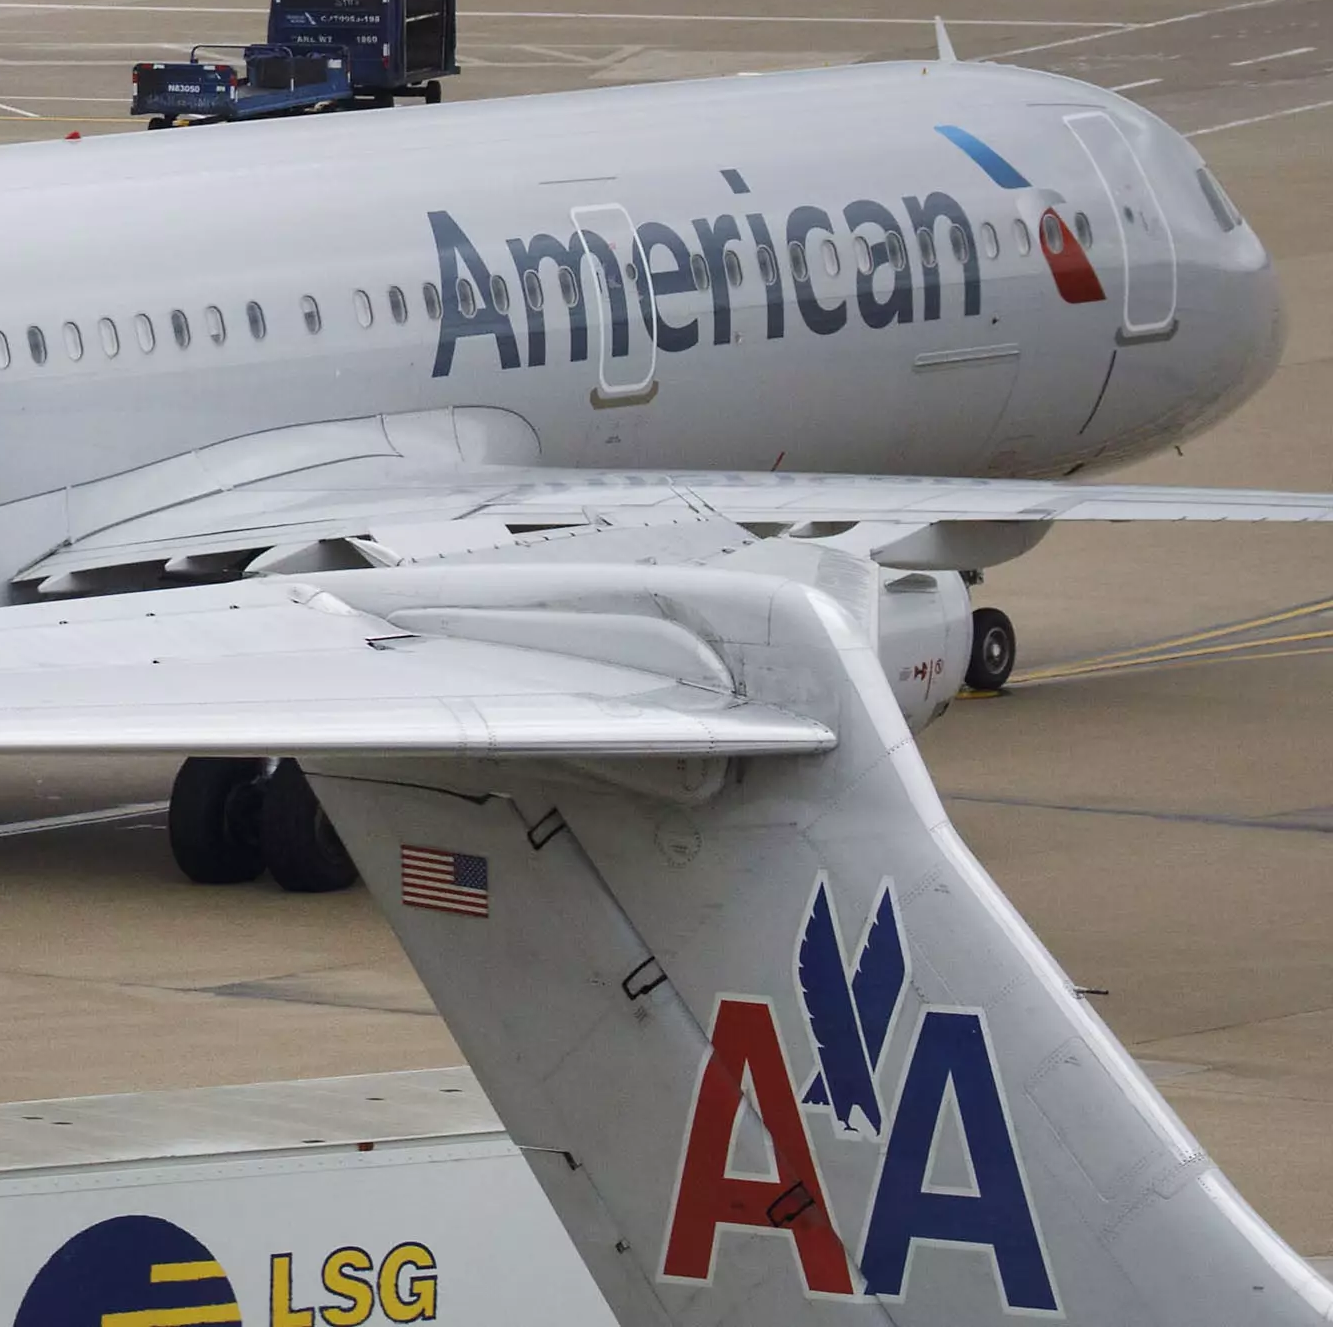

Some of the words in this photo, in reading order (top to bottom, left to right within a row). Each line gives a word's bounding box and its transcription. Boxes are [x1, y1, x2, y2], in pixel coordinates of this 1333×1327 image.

[427, 169, 981, 378] American
[659, 994, 1063, 1316] AA
[270, 1241, 438, 1327] LSG
